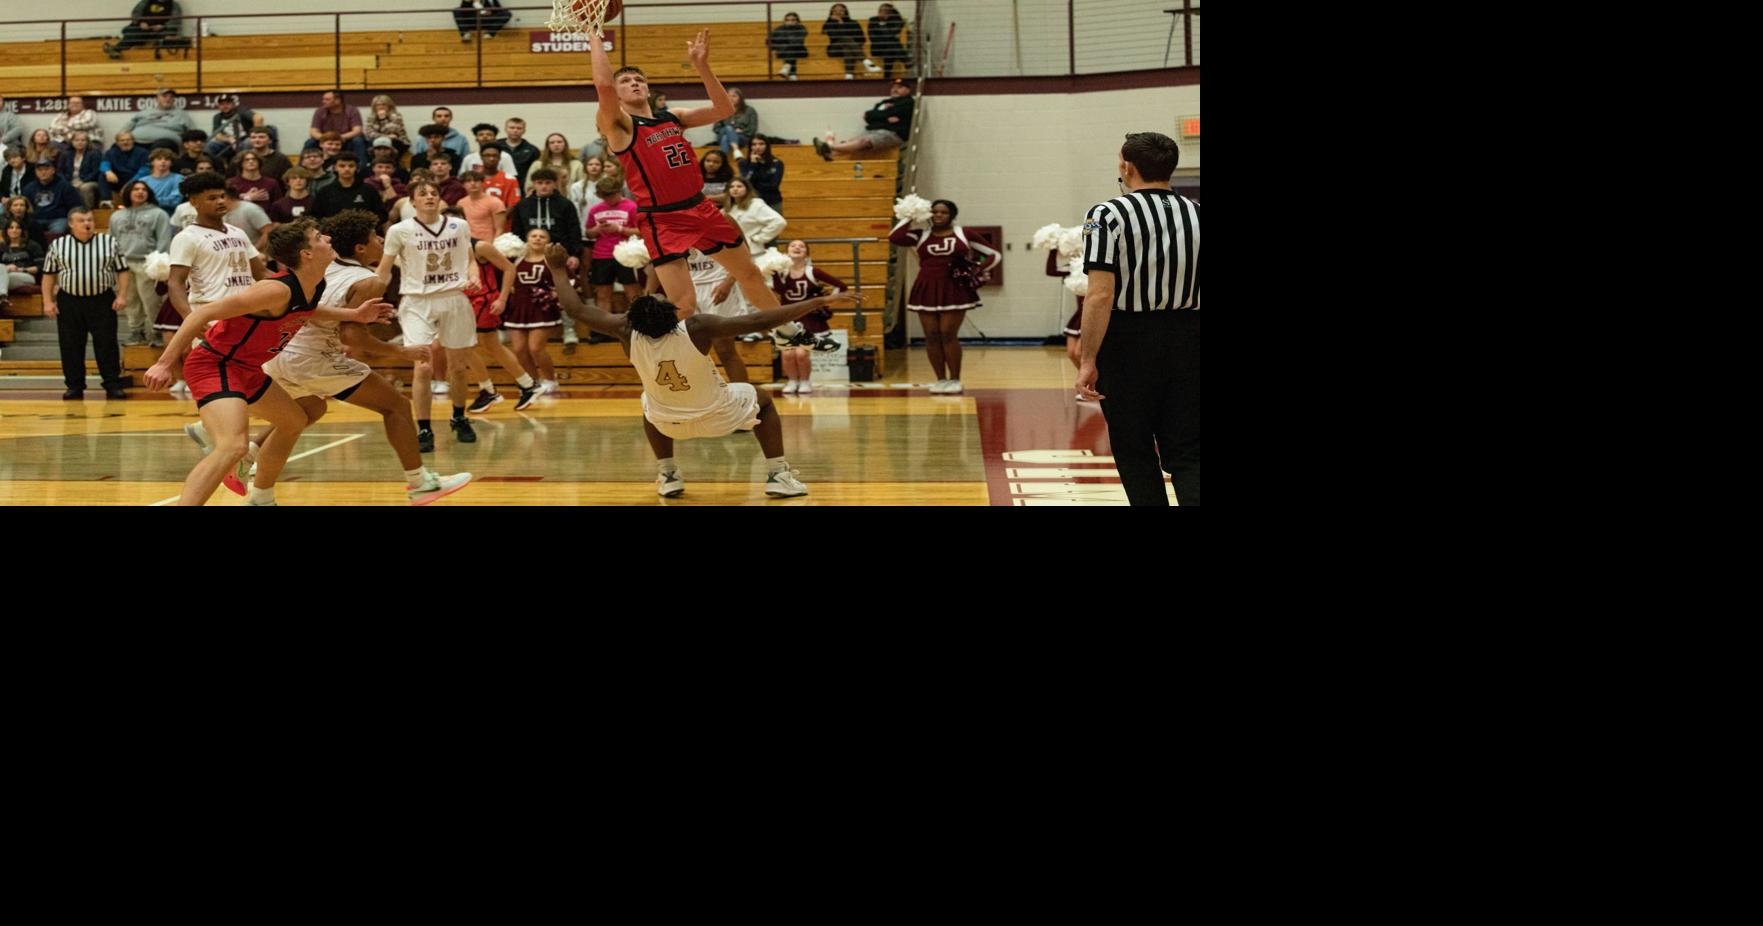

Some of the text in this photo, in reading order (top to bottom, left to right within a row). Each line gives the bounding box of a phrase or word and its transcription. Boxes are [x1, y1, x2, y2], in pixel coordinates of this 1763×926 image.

[550, 32, 590, 42] HOM
[531, 41, 614, 53] STUDENS
[96, 97, 132, 111] KATIE
[416, 237, 458, 251] JIMTOWN
[927, 237, 956, 256] J
[517, 264, 545, 285] J
[785, 280, 807, 301] J
[655, 360, 691, 392] 4
